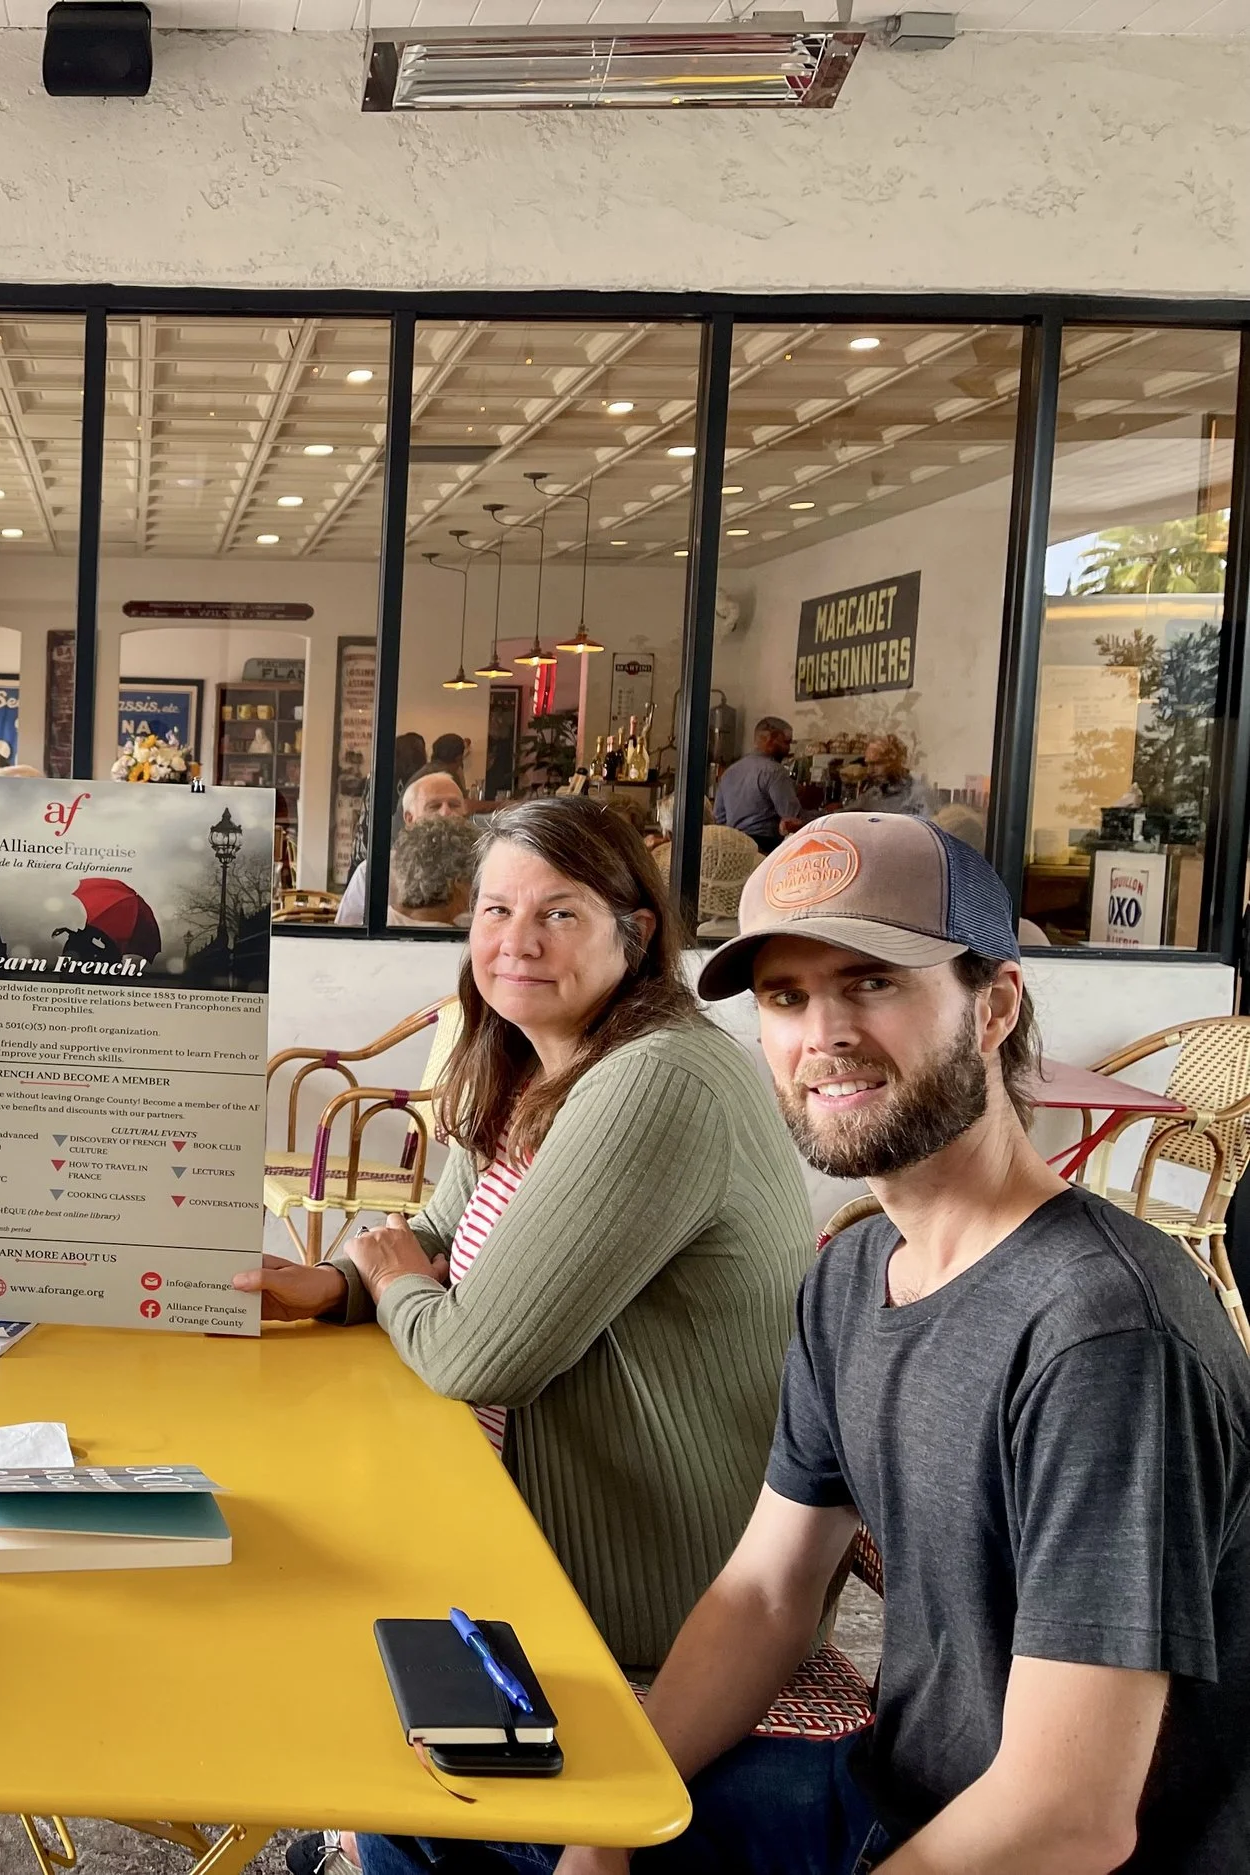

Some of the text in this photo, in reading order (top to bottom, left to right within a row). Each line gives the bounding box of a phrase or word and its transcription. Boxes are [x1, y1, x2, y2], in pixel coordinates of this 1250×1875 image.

[814, 586, 898, 644] MARCADET
[797, 637, 911, 695] POISSONNIERS
[44, 793, 91, 837] af
[12, 858, 23, 868] la
[26, 859, 62, 870] Riviera
[64, 861, 132, 873] Californienne
[787, 856, 831, 876] BLACK
[775, 868, 842, 893] DIAMOND
[1108, 895, 1142, 928] OXO
[52, 956, 147, 977] French!
[40, 986, 85, 996] nonprofit
[86, 988, 125, 997] network
[126, 990, 151, 998] since
[153, 991, 176, 1000] 1883
[188, 994, 229, 1002] promote
[231, 995, 264, 1004] French
[22, 993, 49, 1002] foster
[50, 996, 88, 1004] positive
[89, 997, 131, 1007] relations
[132, 999, 172, 1009] between
[174, 1001, 241, 1012] Francophones
[243, 1005, 261, 1013] and
[5, 1021, 47, 1032] 501(c)(3)
[48, 1024, 97, 1034] non-profit
[0, 1039, 38, 1050] friendly
[39, 1041, 58, 1050] and
[59, 1044, 110, 1053] supportive
[111, 1046, 173, 1056] environment
[186, 1048, 211, 1058] learn
[213, 1050, 247, 1060] French
[36, 1071, 61, 1080] AND
[62, 1072, 110, 1083] BECOME
[122, 1075, 170, 1086] MEMBER
[5, 1090, 39, 1099] without
[40, 1092, 72, 1102] leaving
[72, 1094, 105, 1104] Orange
[142, 1097, 176, 1107] Become
[184, 1101, 220, 1109] member
[221, 1102, 231, 1110] of
[232, 1103, 247, 1111] the
[110, 1126, 197, 1138] CULTURAL EVENTS
[69, 1135, 117, 1144] DISCOVERY
[132, 1138, 167, 1147] FRENCH
[192, 1142, 242, 1151] BOOK CLUB
[68, 1146, 108, 1155] CULTURE
[68, 1160, 90, 1168] HOW
[91, 1162, 104, 1170] TO
[104, 1162, 136, 1171] TRAVEL
[192, 1167, 235, 1176] LECTURES
[68, 1171, 102, 1180] FRANCE
[66, 1191, 146, 1202] COOKING CLASSES
[188, 1198, 259, 1209] CONVERSATIONS
[27, 1208, 44, 1216] (the
[44, 1209, 62, 1217] best
[89, 1211, 121, 1221] library)
[25, 1249, 58, 1260] MORE
[60, 1252, 100, 1262] ABOUT
[101, 1253, 117, 1263] US
[9, 1284, 104, 1298] www.aforange.org
[166, 1302, 247, 1315] Alliance Française
[168, 1315, 244, 1328] d'Orange County
